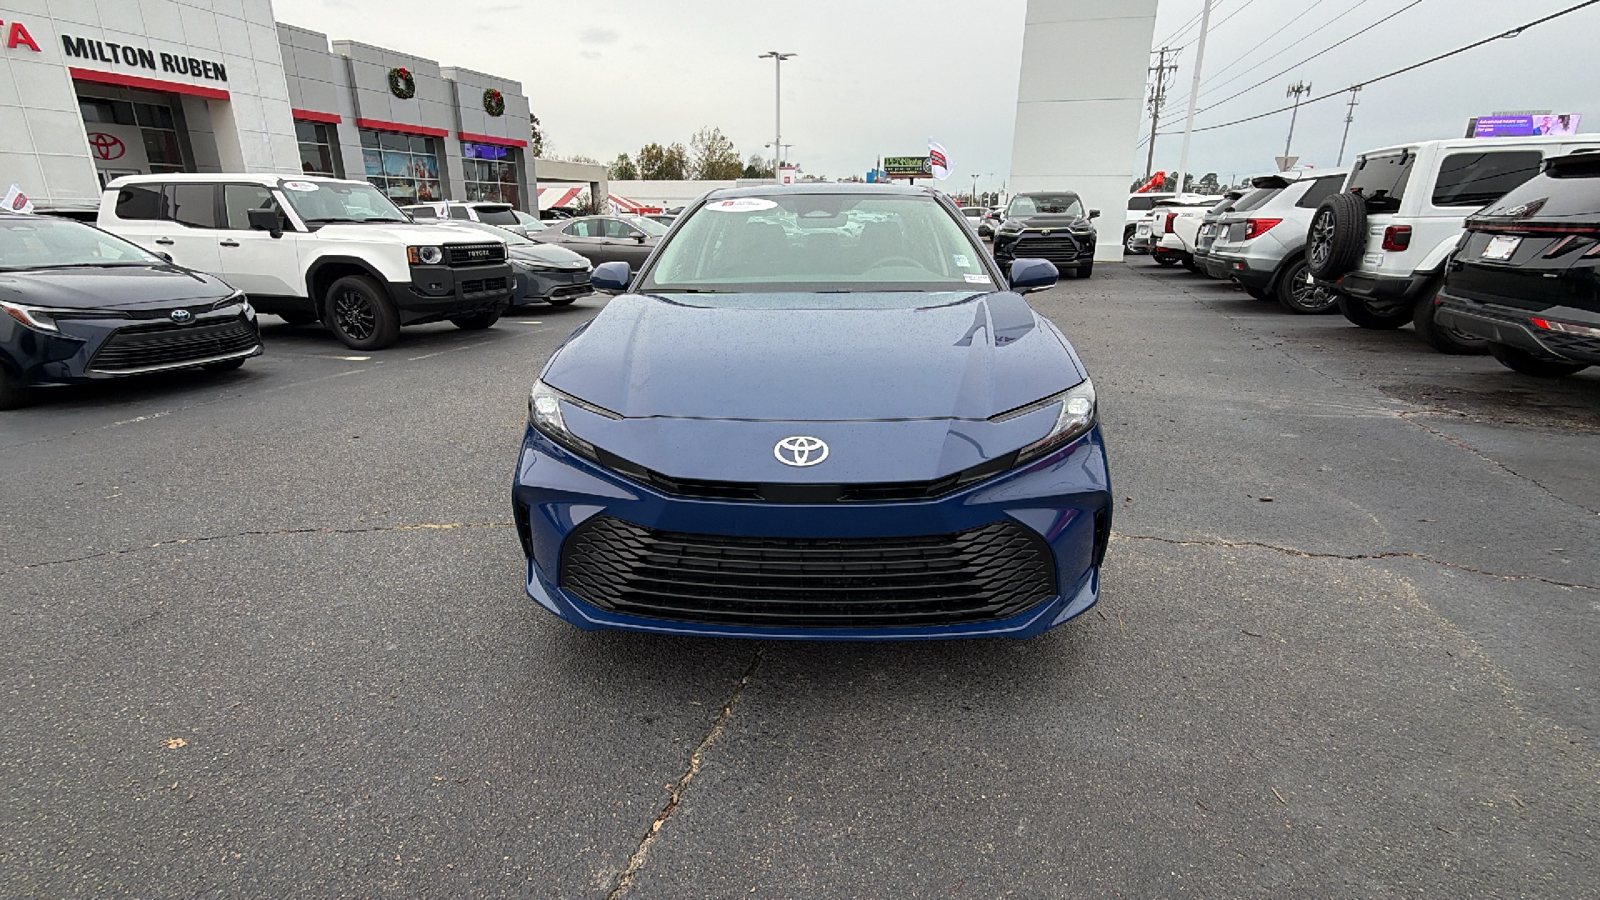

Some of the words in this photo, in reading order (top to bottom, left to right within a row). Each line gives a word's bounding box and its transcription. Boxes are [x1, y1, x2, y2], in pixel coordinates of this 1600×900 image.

[0, 19, 42, 52] A
[61, 34, 156, 70] MILTON
[160, 52, 228, 82] RUBEN
